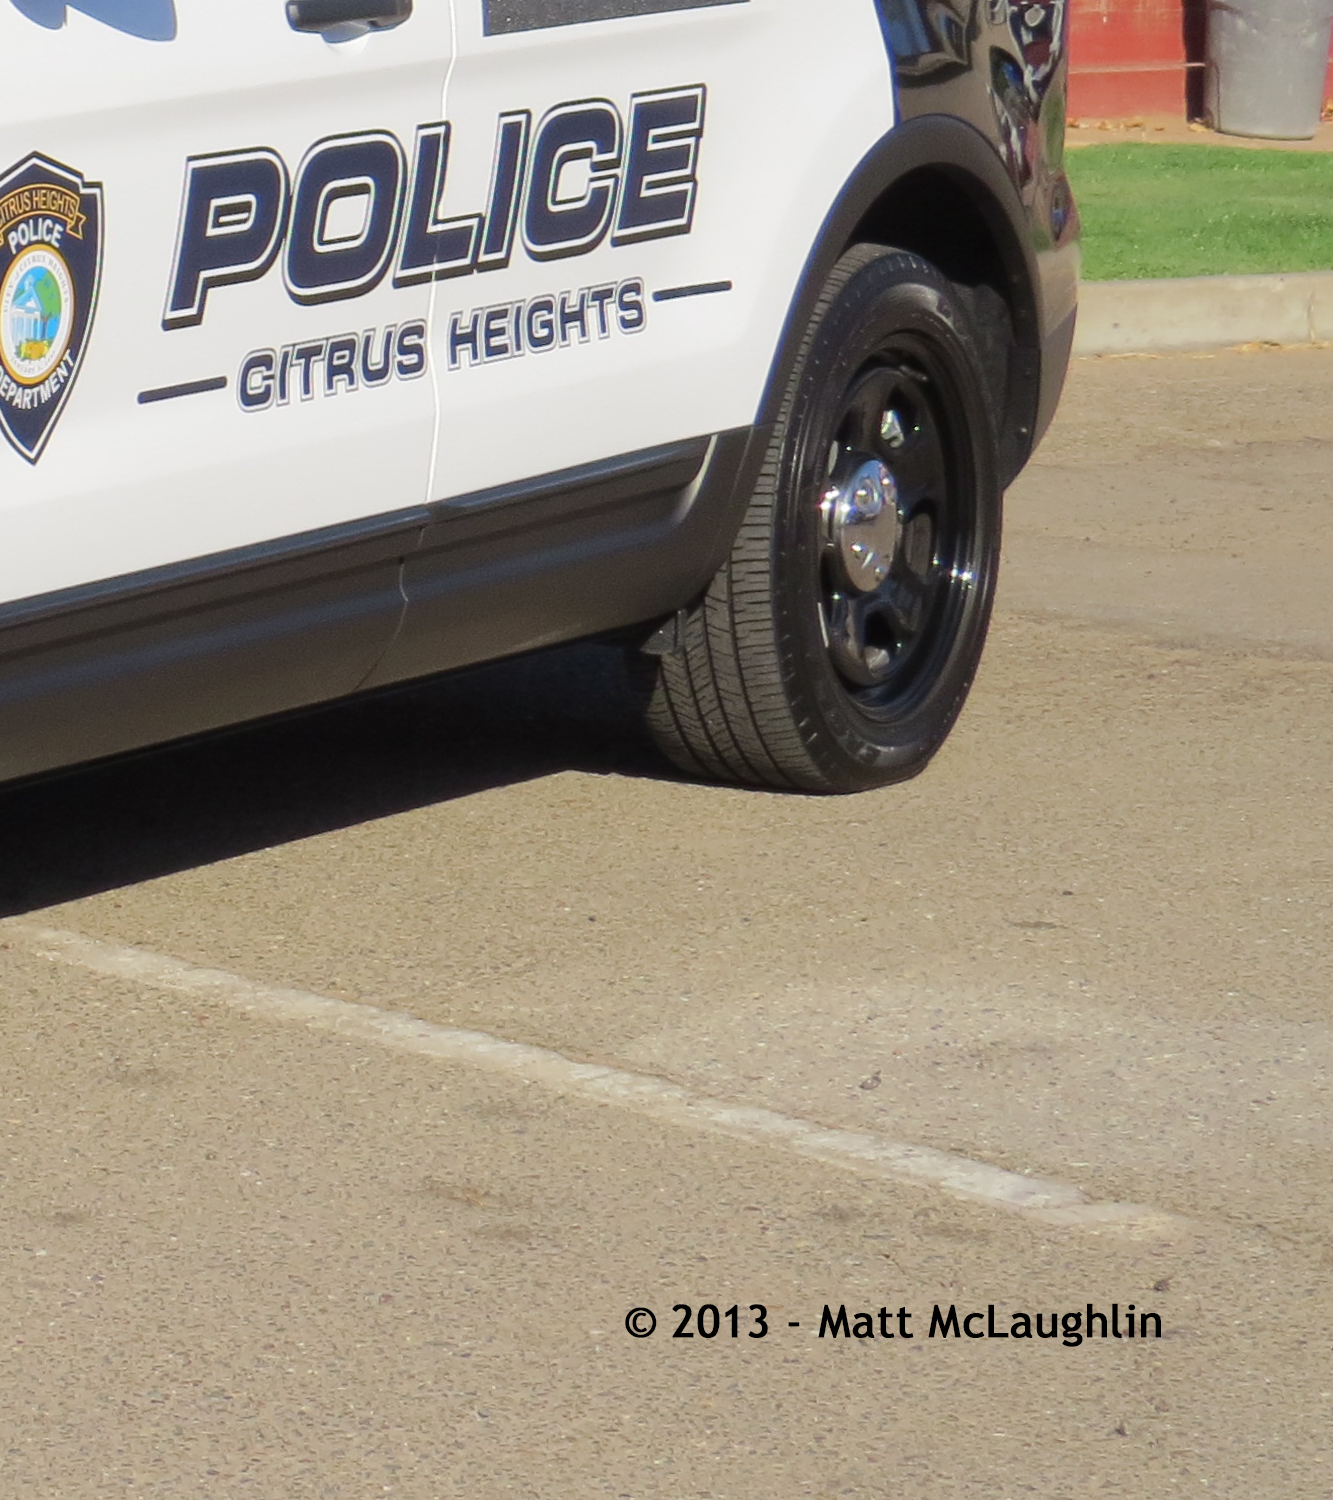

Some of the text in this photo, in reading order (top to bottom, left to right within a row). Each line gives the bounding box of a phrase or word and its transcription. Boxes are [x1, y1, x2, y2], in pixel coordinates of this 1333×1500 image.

[7, 217, 65, 255] POLICE
[32, 189, 77, 218] HEIGHTS
[160, 83, 708, 331] POLICE
[236, 276, 648, 413] CITRUS HEIGHTS
